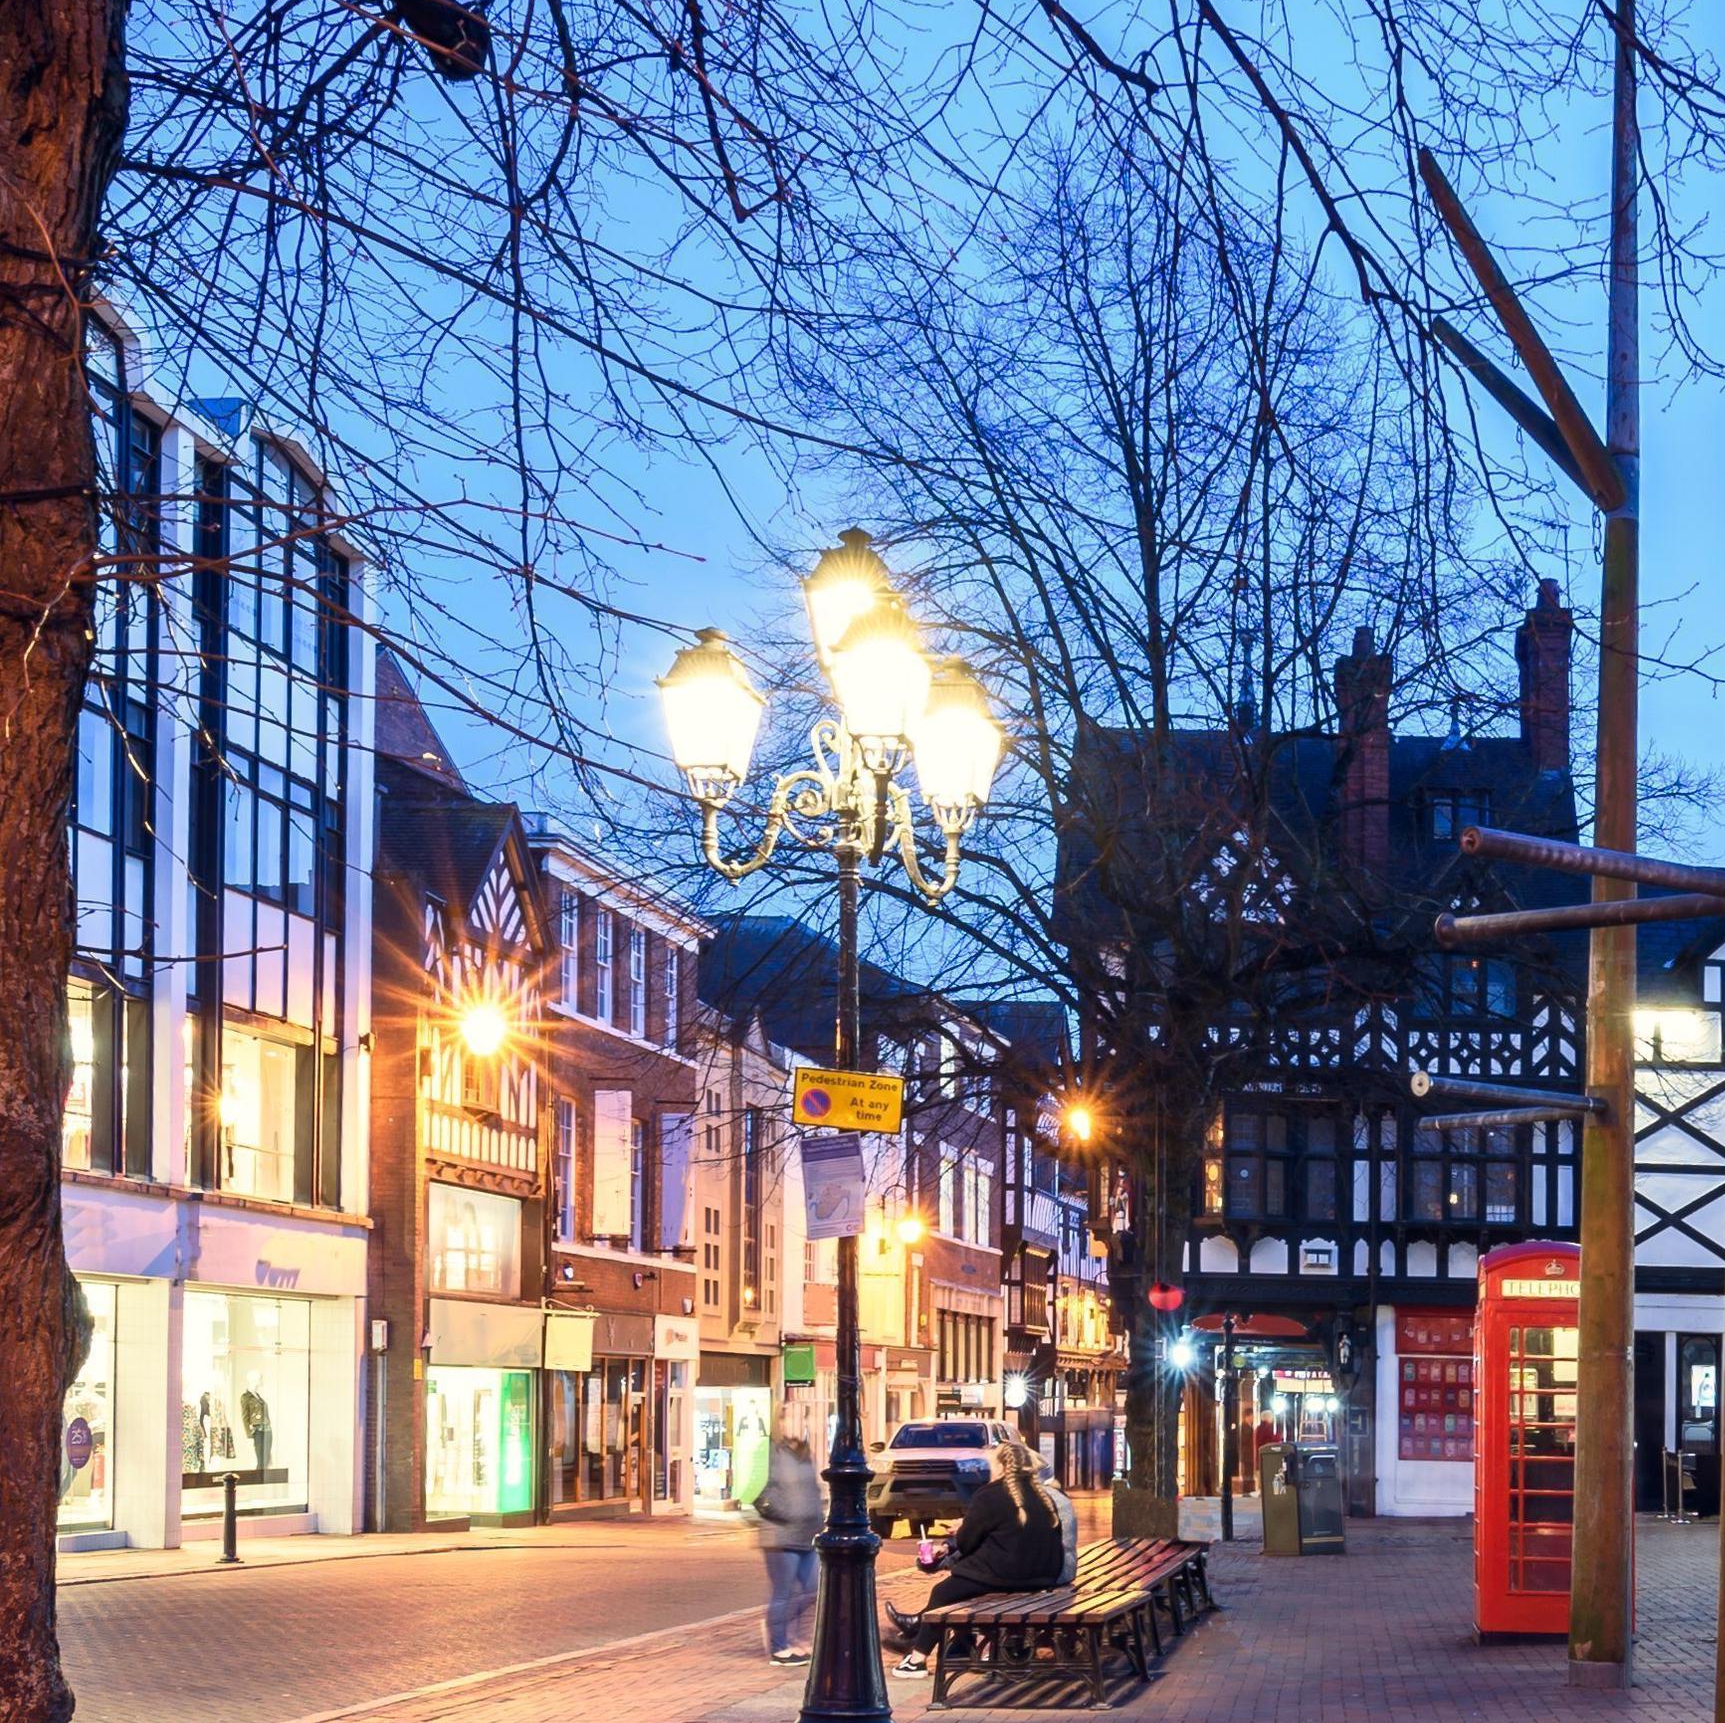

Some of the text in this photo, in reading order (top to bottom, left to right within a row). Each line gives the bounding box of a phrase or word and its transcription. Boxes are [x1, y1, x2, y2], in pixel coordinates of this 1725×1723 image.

[801, 1073, 898, 1092] Pedestrian Zone
[850, 1097, 889, 1111] At any
[856, 1111, 882, 1121] time
[1506, 1281, 1580, 1295] TELEPHO
